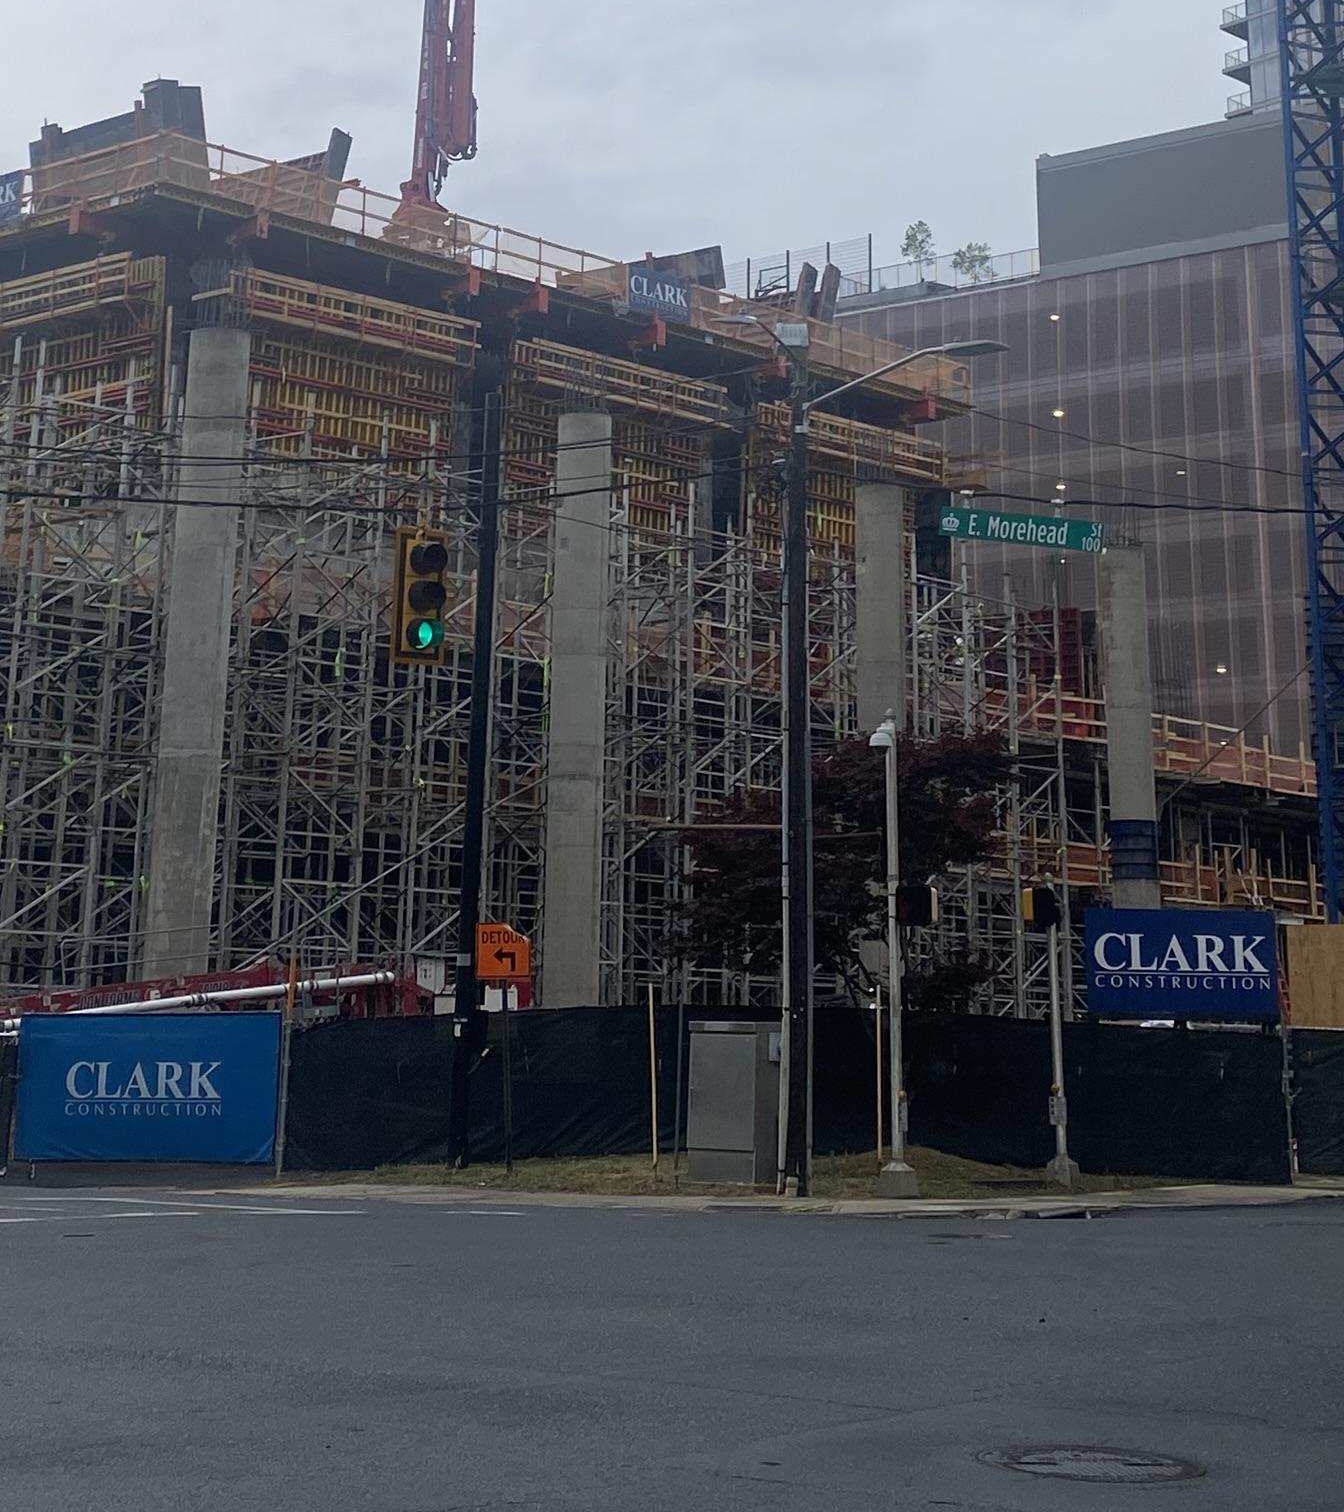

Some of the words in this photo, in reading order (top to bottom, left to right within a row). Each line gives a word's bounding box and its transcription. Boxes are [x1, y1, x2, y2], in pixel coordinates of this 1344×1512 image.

[630, 274, 688, 308] CLARK
[967, 514, 981, 537] E.
[987, 515, 1069, 545] Morehead
[1090, 522, 1104, 537] St
[1081, 536, 1101, 552] 100
[1093, 932, 1270, 973] CLARK
[1095, 974, 1272, 990] CONSTRUCTION
[65, 1060, 222, 1099] CLARK
[64, 1102, 222, 1117] CONSTRUCTION
